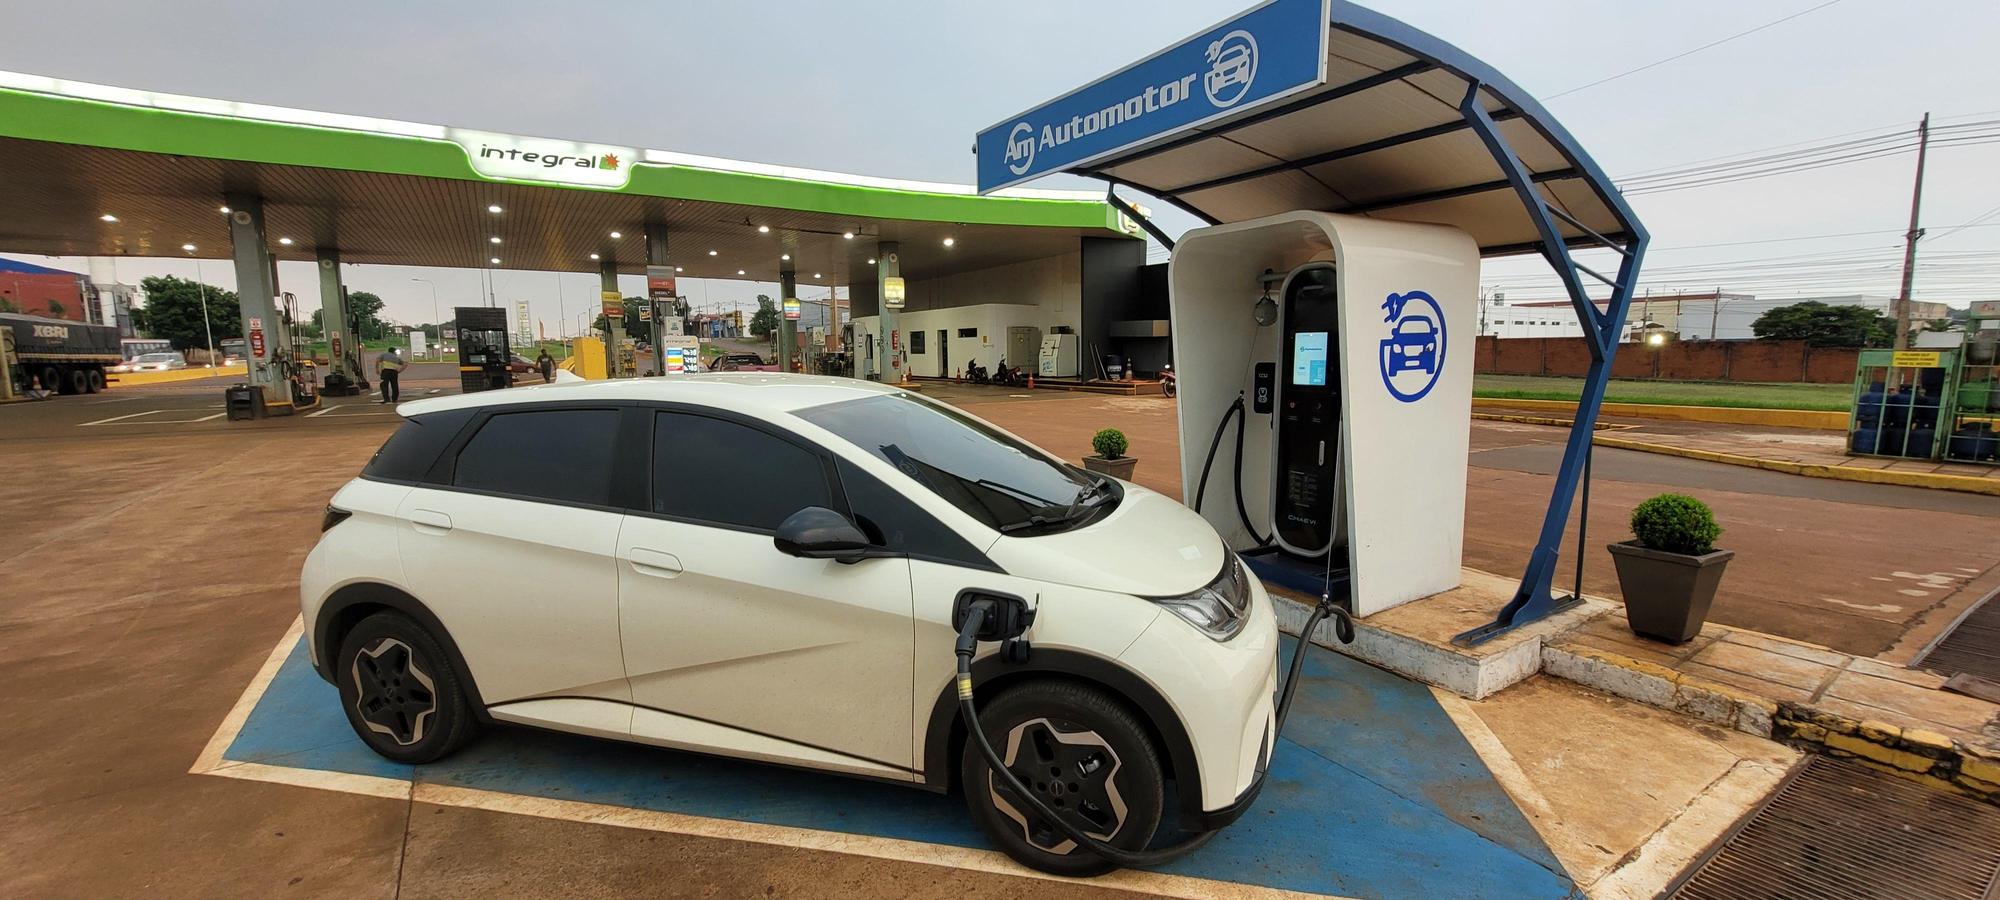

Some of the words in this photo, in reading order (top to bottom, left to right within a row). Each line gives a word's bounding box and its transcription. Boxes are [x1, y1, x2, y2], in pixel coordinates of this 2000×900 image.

[1039, 72, 1197, 152] Automotor
[480, 143, 596, 168] integral
[33, 325, 69, 338] XBRI
